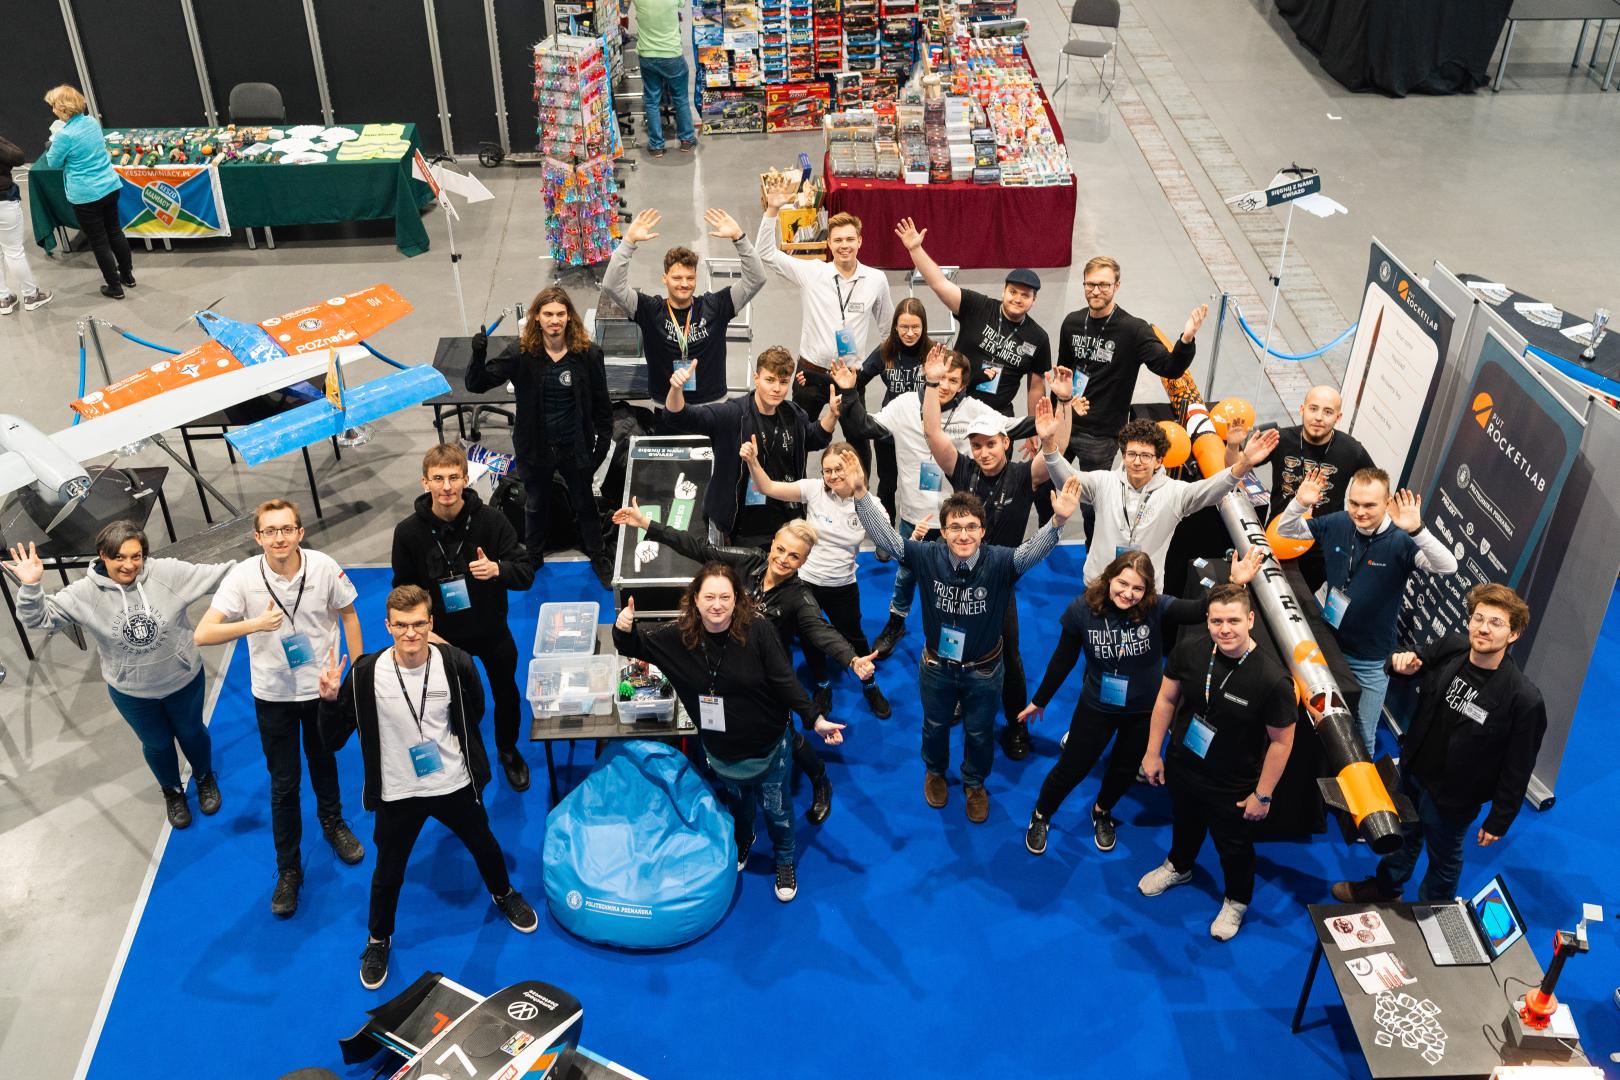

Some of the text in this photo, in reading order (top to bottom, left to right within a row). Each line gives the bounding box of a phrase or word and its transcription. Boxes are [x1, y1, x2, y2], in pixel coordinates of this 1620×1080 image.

[144, 188, 171, 208] MANIACY
[160, 184, 177, 199] KESZO
[1406, 296, 1439, 332] ROCKETLAB
[1492, 412, 1505, 429] PUT
[1486, 421, 1545, 492] ROCKETLAB
[960, 587, 973, 602] ME
